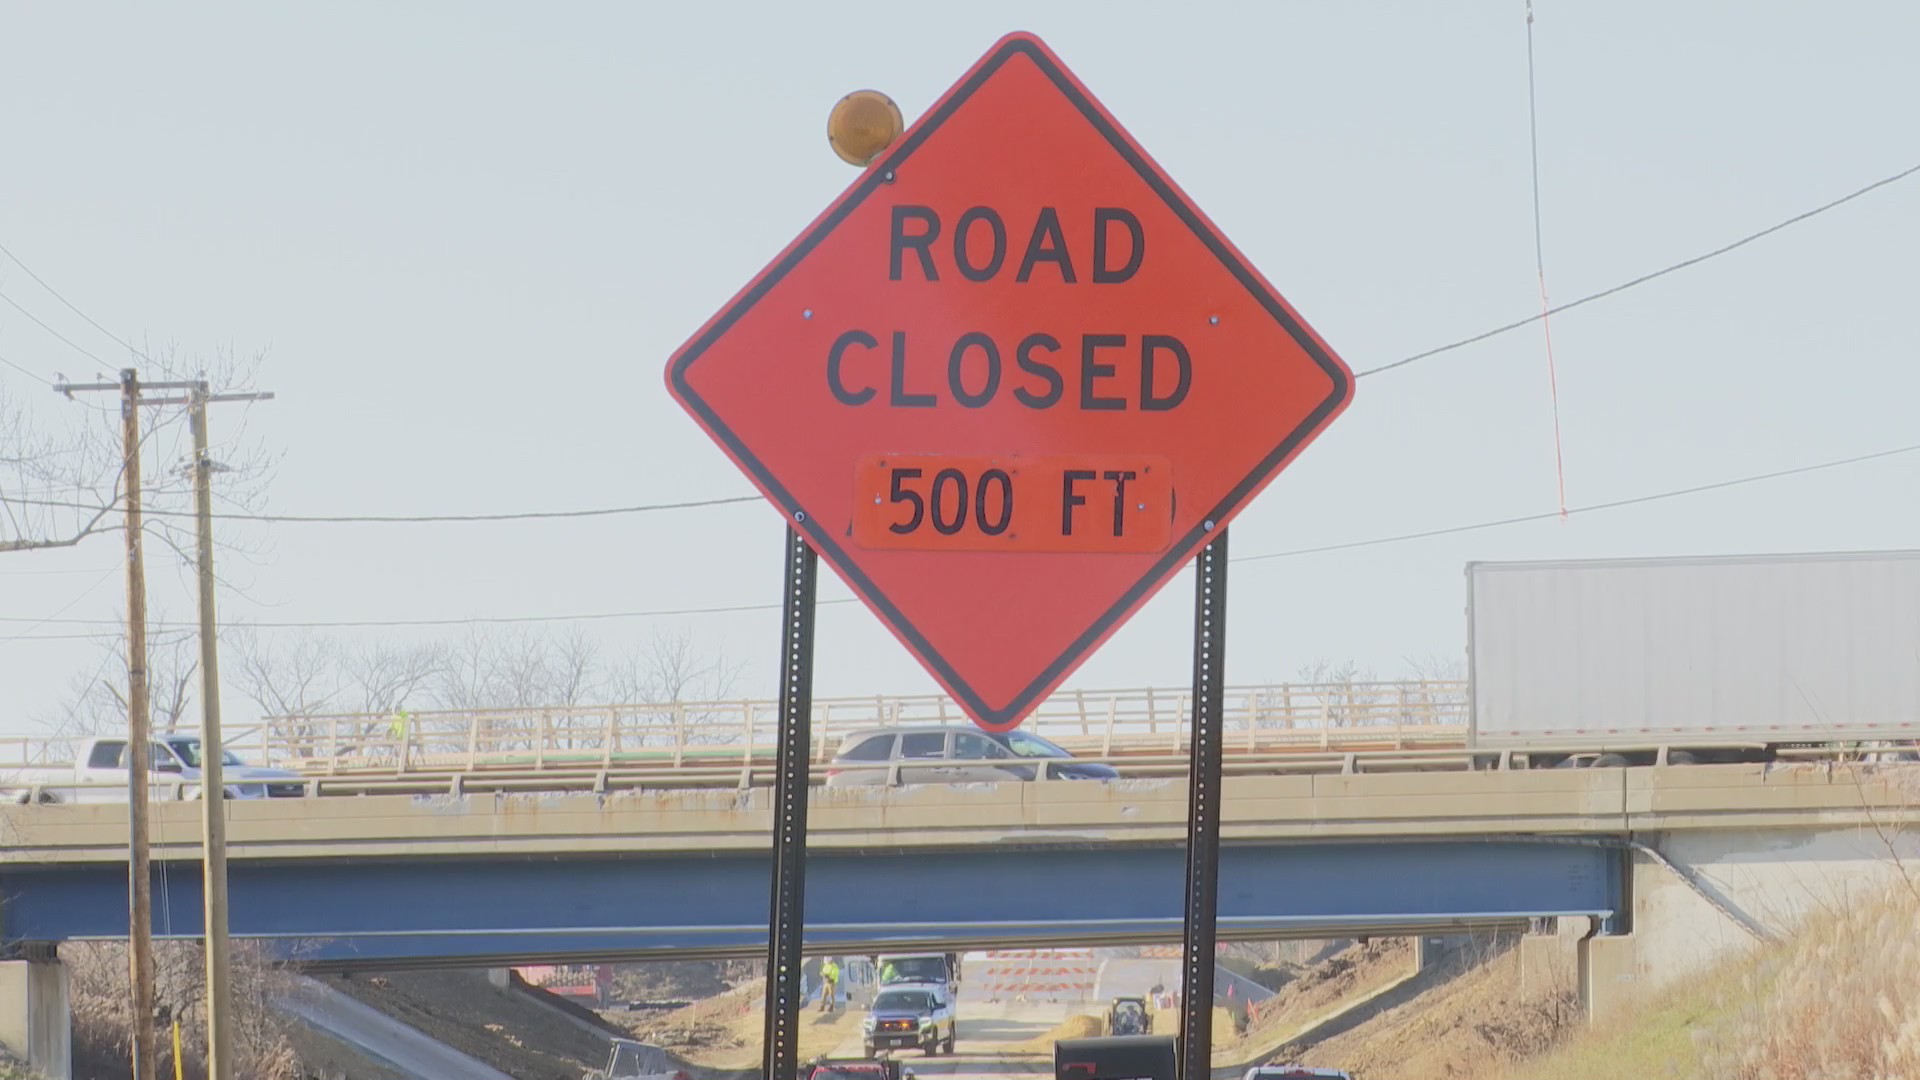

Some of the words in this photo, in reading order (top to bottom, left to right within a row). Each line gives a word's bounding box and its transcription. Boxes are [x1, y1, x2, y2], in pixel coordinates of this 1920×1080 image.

[889, 205, 1145, 284] ROAD
[827, 330, 1193, 412] CLOSED
[889, 468, 1014, 536] 500
[1062, 470, 1137, 537] FT
